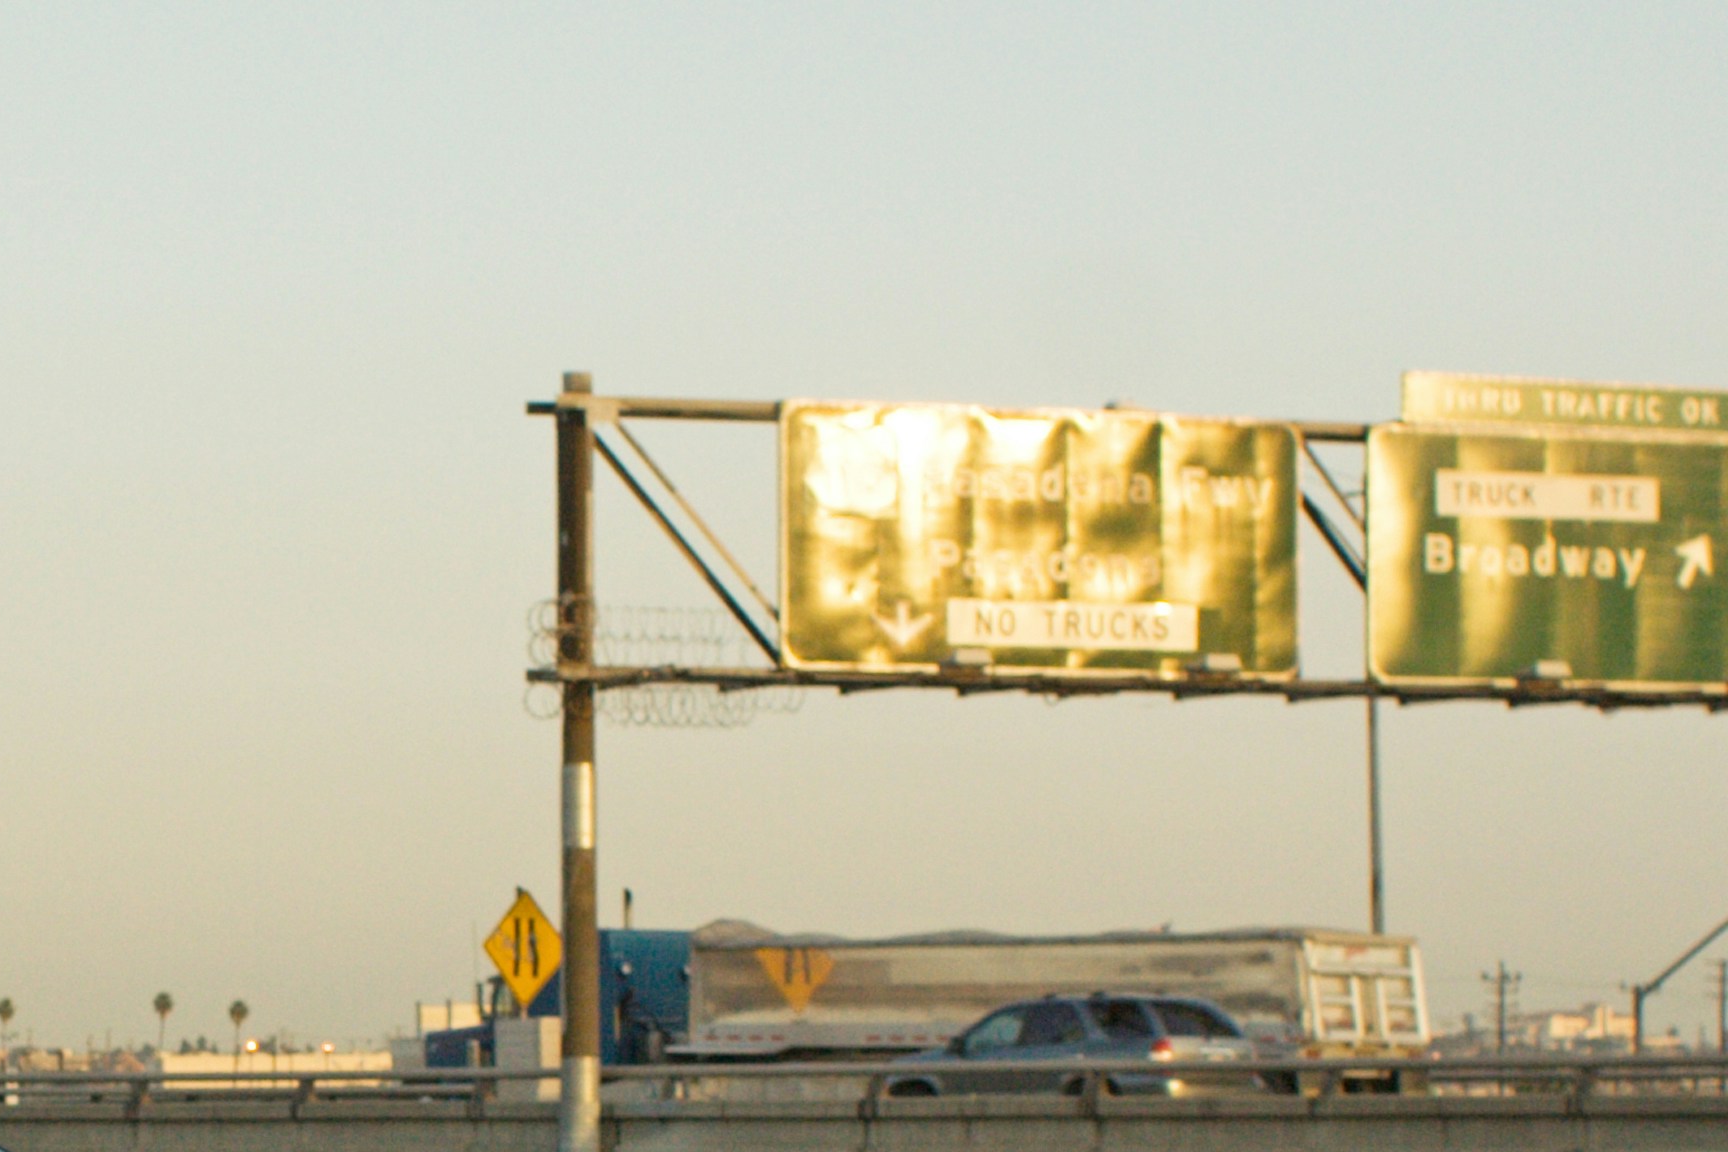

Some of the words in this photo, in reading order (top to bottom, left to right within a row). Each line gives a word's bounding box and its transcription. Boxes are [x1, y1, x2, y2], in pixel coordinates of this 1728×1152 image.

[1442, 387, 1522, 414] THRU
[1540, 391, 1662, 422] TRAFFIC
[1679, 398, 1719, 426] OK
[1451, 480, 1538, 507] TRUCK
[1587, 485, 1641, 511] RTE
[1423, 532, 1646, 589] Broadway
[974, 608, 1017, 638] NO
[1043, 609, 1170, 641] TRUCKS
